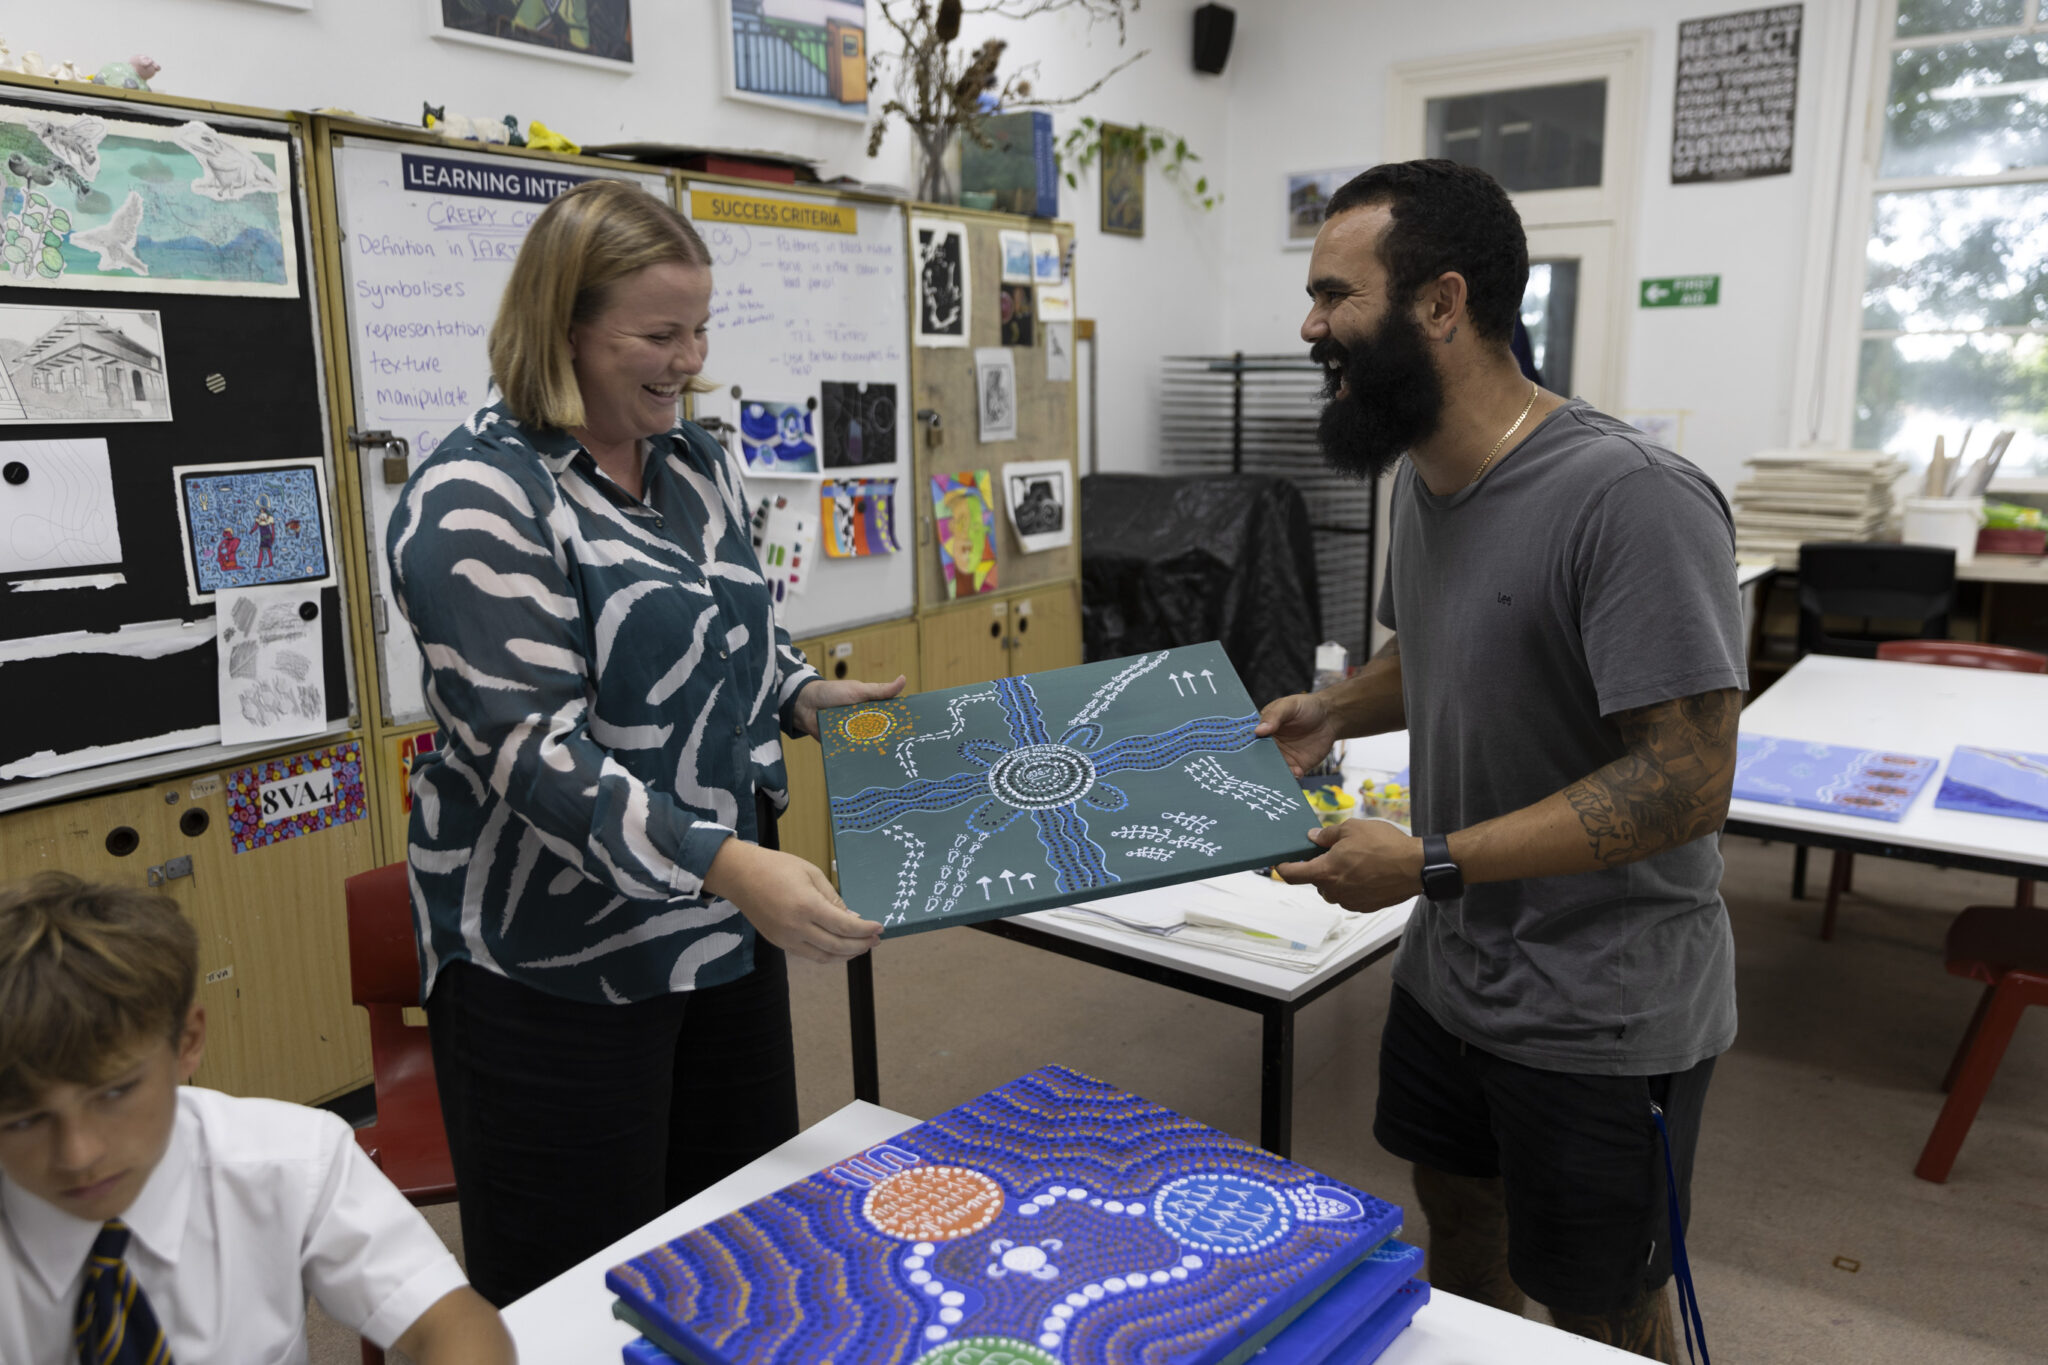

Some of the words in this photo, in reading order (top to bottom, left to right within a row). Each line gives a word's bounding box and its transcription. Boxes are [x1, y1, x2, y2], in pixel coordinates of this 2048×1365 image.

[1681, 25, 1797, 58] RESPECT
[1680, 51, 1795, 74] ABORIGINAL
[1680, 75, 1719, 91] AND
[1722, 68, 1794, 87] TORRES
[1677, 113, 1790, 136] TRADITIONAL
[1674, 130, 1791, 158] CUSTODIANS
[409, 163, 520, 195] LEARNING
[1674, 161, 1696, 177] OF
[427, 201, 497, 226] CREEPY
[712, 199, 778, 222] SUCCESS
[781, 207, 841, 227] CRITERIA
[358, 233, 436, 257] Definition
[448, 241, 464, 257] in
[356, 280, 466, 309] Symbolises
[1672, 276, 1714, 292] FIRST
[1680, 291, 1707, 305] AID
[365, 317, 486, 341] representation
[370, 351, 442, 373] texture
[377, 387, 469, 409] manipulate
[1497, 591, 1512, 606] Lee
[1012, 750, 1029, 758] NOW
[262, 780, 334, 816] 8VA4
